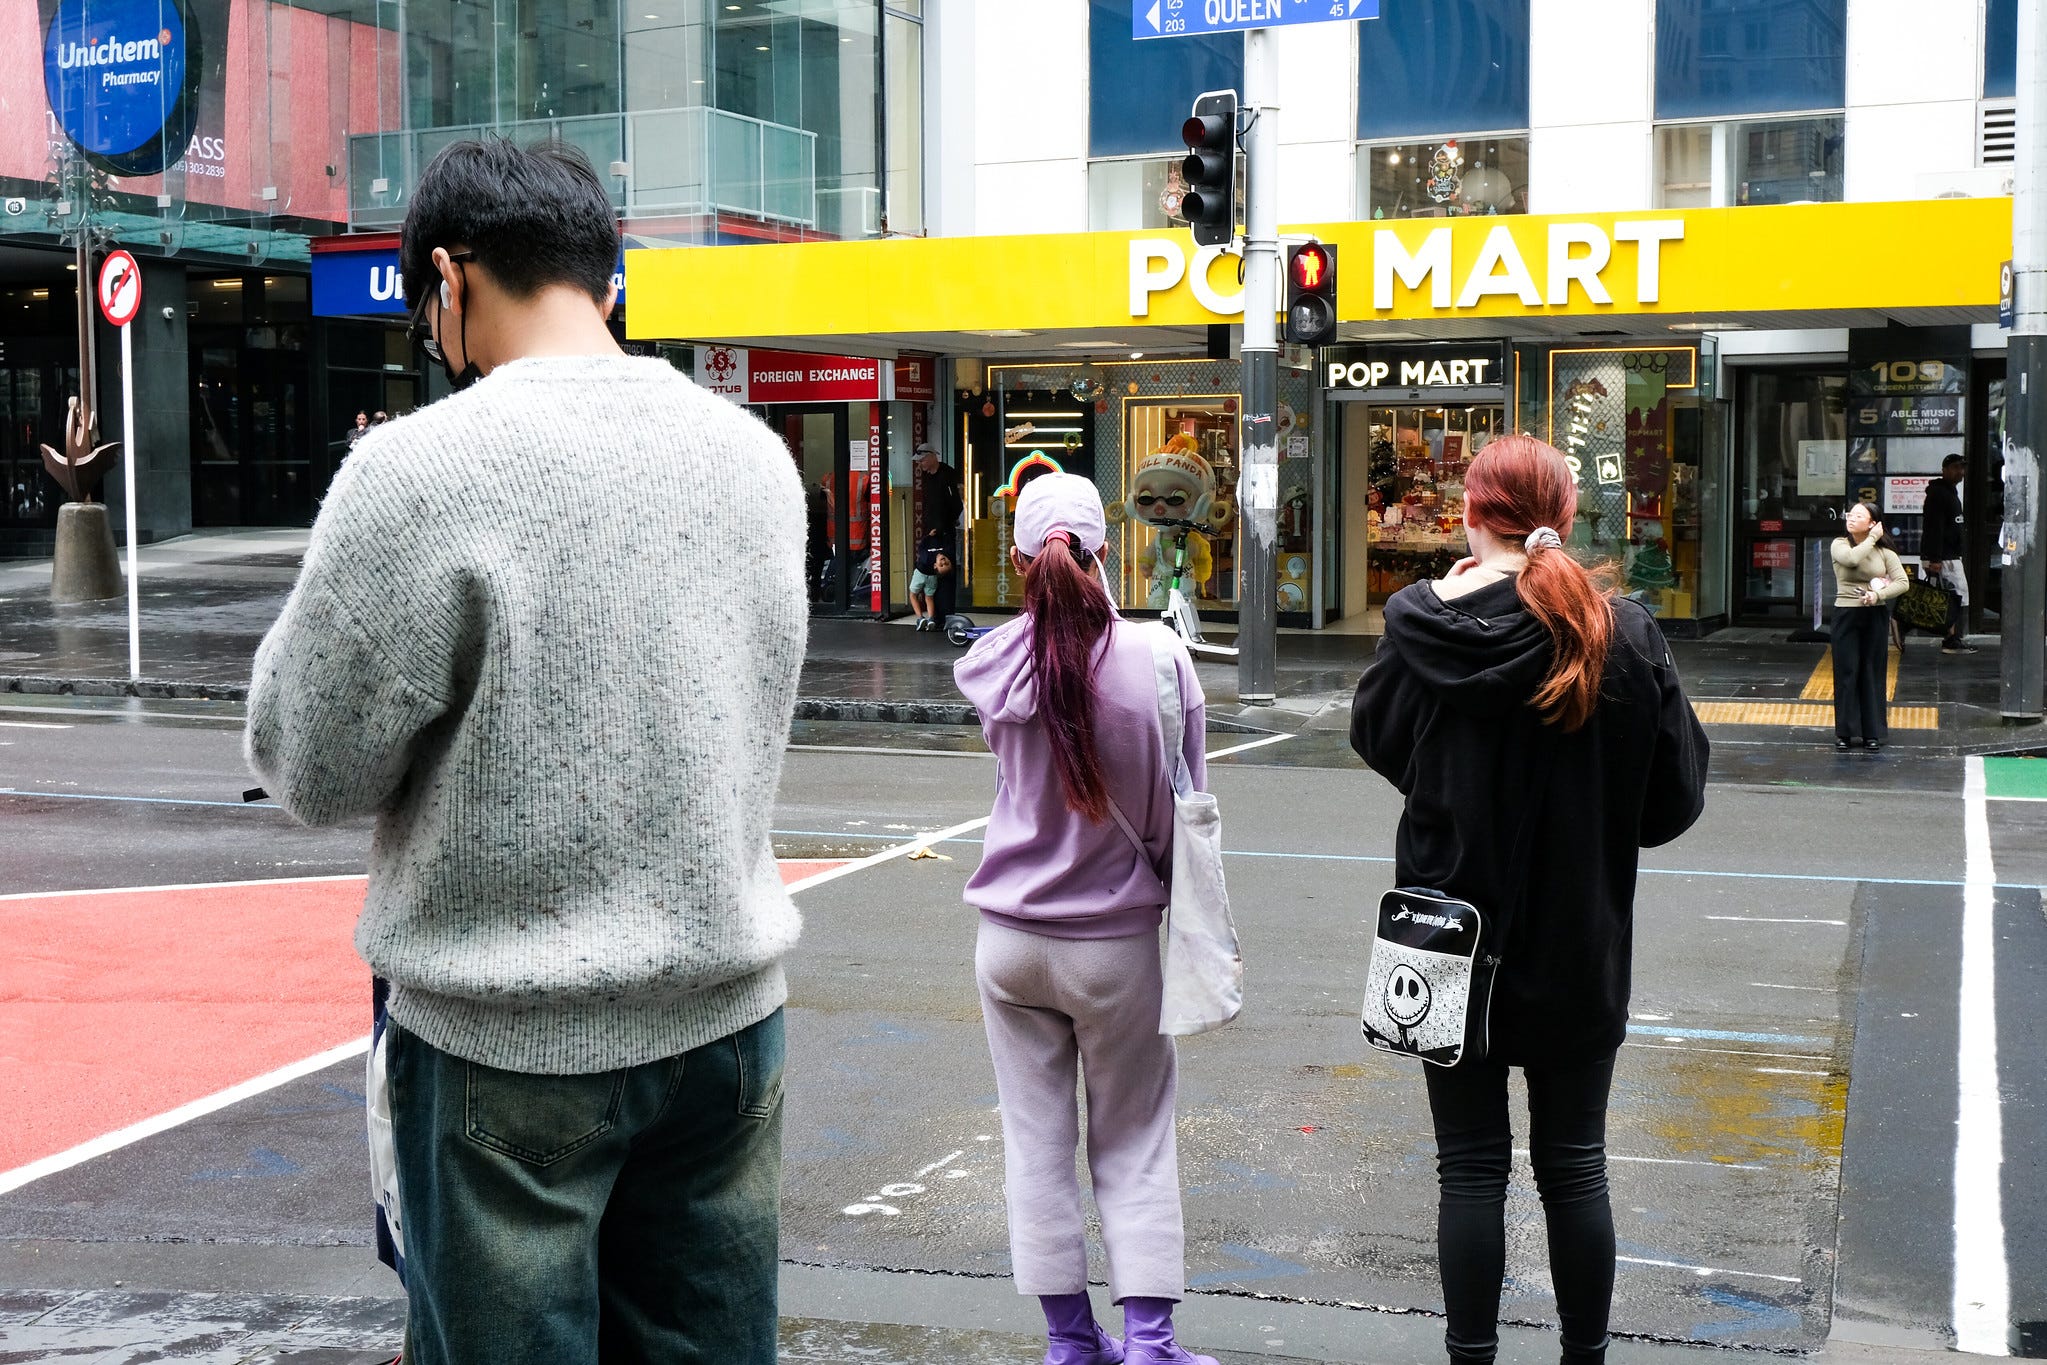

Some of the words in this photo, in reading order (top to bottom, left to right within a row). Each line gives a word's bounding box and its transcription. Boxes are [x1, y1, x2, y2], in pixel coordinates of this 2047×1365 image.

[1204, 0, 1281, 25] QUEEN
[1329, 3, 1344, 17] 45
[1165, 19, 1185, 33] 203
[58, 35, 160, 69] Unichem
[102, 70, 160, 87] Pharmacy
[184, 134, 225, 161] ASS
[188, 161, 205, 175] 303
[205, 164, 225, 178] 2839
[1129, 236, 1288, 316] PO
[1373, 219, 1685, 309] MART
[753, 371, 803, 384] FOREIGN
[809, 368, 875, 382] EXCHANGE
[1328, 362, 1389, 388] POP
[1400, 359, 1490, 386] MART
[1871, 361, 1945, 383] 109
[708, 385, 742, 395] OTUS
[1859, 408, 1879, 425] 5
[1890, 410, 1919, 419] ABLE
[1921, 408, 1956, 418] MUSIC
[1906, 418, 1940, 426] STUDIO
[870, 425, 881, 494] FOREIGN
[1165, 457, 1203, 480] PANDA
[1858, 487, 1877, 503] 3
[871, 503, 882, 592] EXCHANGE
[1762, 559, 1781, 567] INLET
